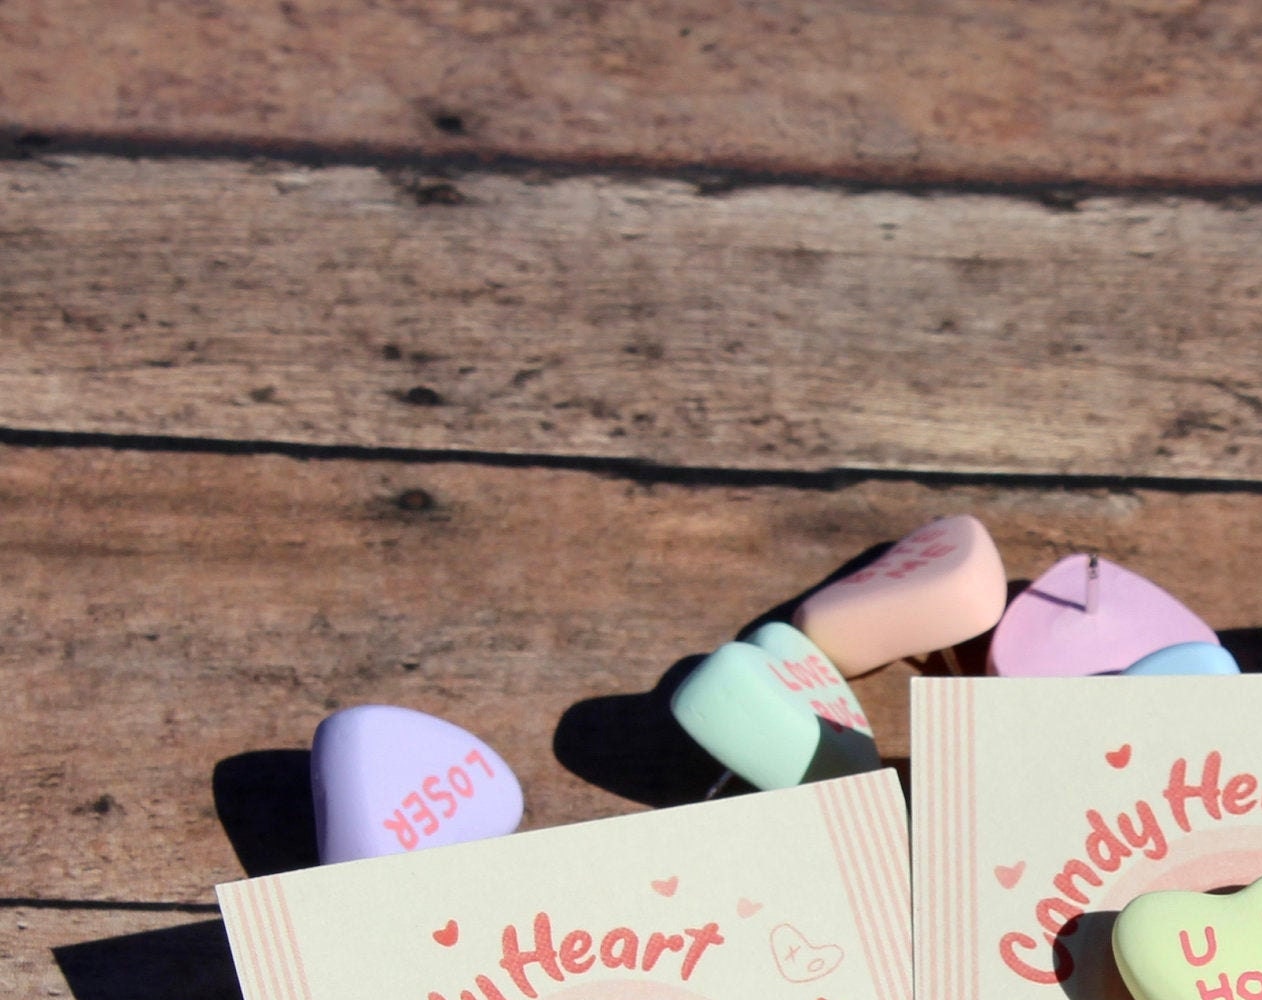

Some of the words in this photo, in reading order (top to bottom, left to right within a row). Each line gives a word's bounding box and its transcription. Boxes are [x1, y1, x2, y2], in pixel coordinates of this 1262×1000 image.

[382, 749, 495, 852] LOSER
[998, 800, 1169, 984] Candy
[499, 911, 725, 999] Heart
[1179, 926, 1217, 967] U
